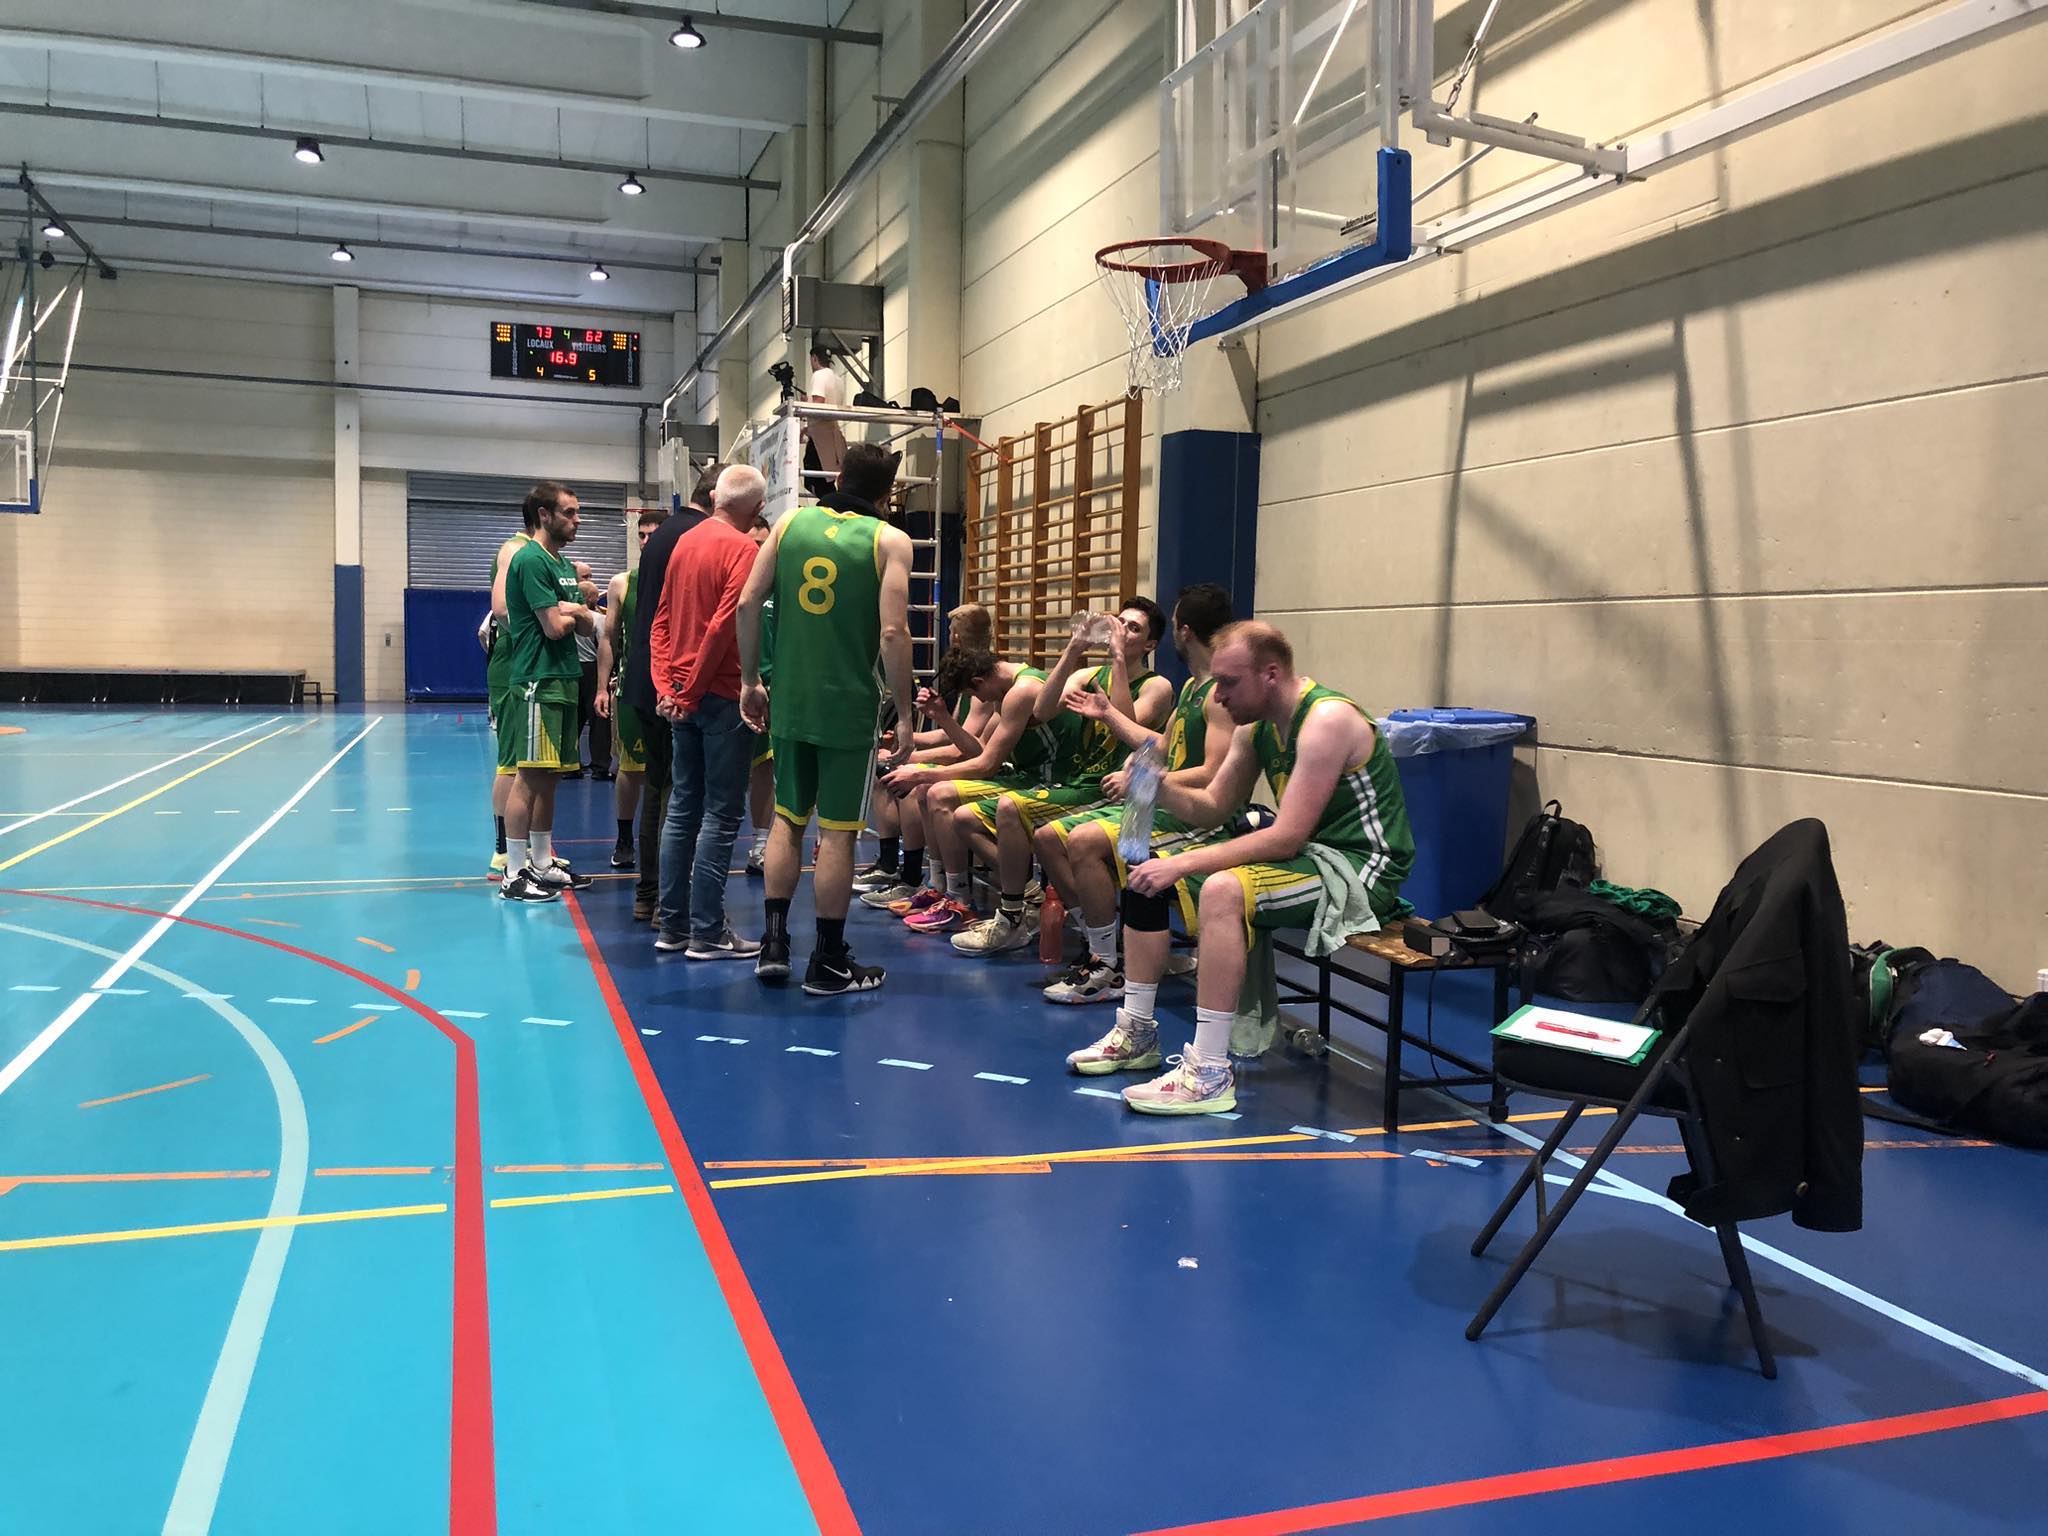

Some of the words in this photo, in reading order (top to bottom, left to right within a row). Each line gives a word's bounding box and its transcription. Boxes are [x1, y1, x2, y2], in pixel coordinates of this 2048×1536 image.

[536, 326, 552, 339] 73
[563, 329, 571, 339] 4
[585, 330, 603, 343] 62
[527, 338, 554, 349] LOCAUX
[571, 342, 607, 353] VISITEURS
[550, 351, 577, 365] 16.9
[536, 366, 544, 376] 4
[588, 369, 596, 381] 5
[798, 556, 838, 615] 8
